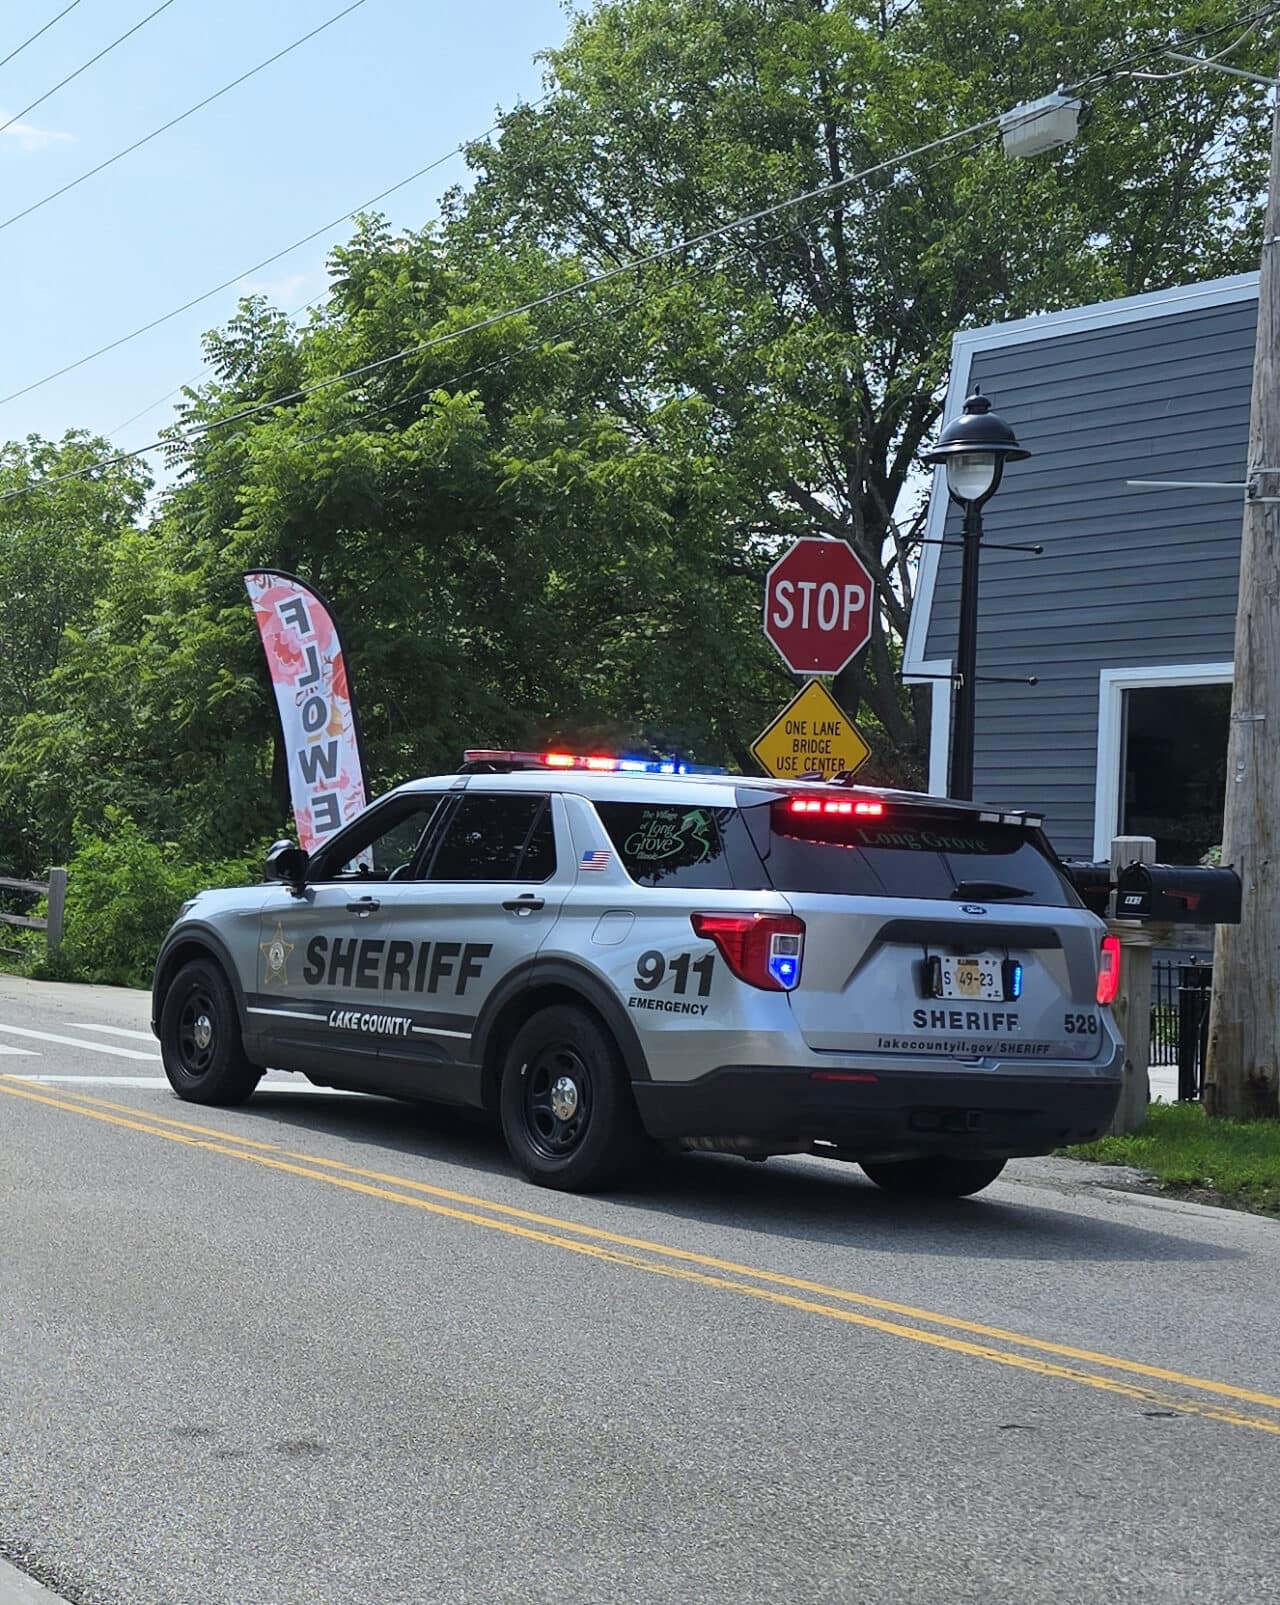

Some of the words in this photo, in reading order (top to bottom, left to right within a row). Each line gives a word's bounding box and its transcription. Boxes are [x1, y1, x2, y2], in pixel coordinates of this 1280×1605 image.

[773, 580, 866, 631] STOP
[785, 720, 807, 735] ONE
[813, 721, 842, 736] LANE
[792, 739, 832, 754] BRIDGE
[776, 757, 798, 772] USE
[803, 757, 846, 772] CENTER
[647, 820, 676, 838] Long
[624, 832, 673, 855] Grove
[303, 935, 494, 996] SHERIFF
[634, 950, 716, 997] 911
[943, 971, 951, 984] S
[960, 971, 993, 987] 49-23
[628, 997, 708, 1016] EMERGENCY
[329, 1010, 359, 1030] LAKE
[360, 1014, 412, 1036] COUNTY
[913, 1009, 1019, 1031] SHERIFF
[1064, 1013, 1098, 1035] 528
